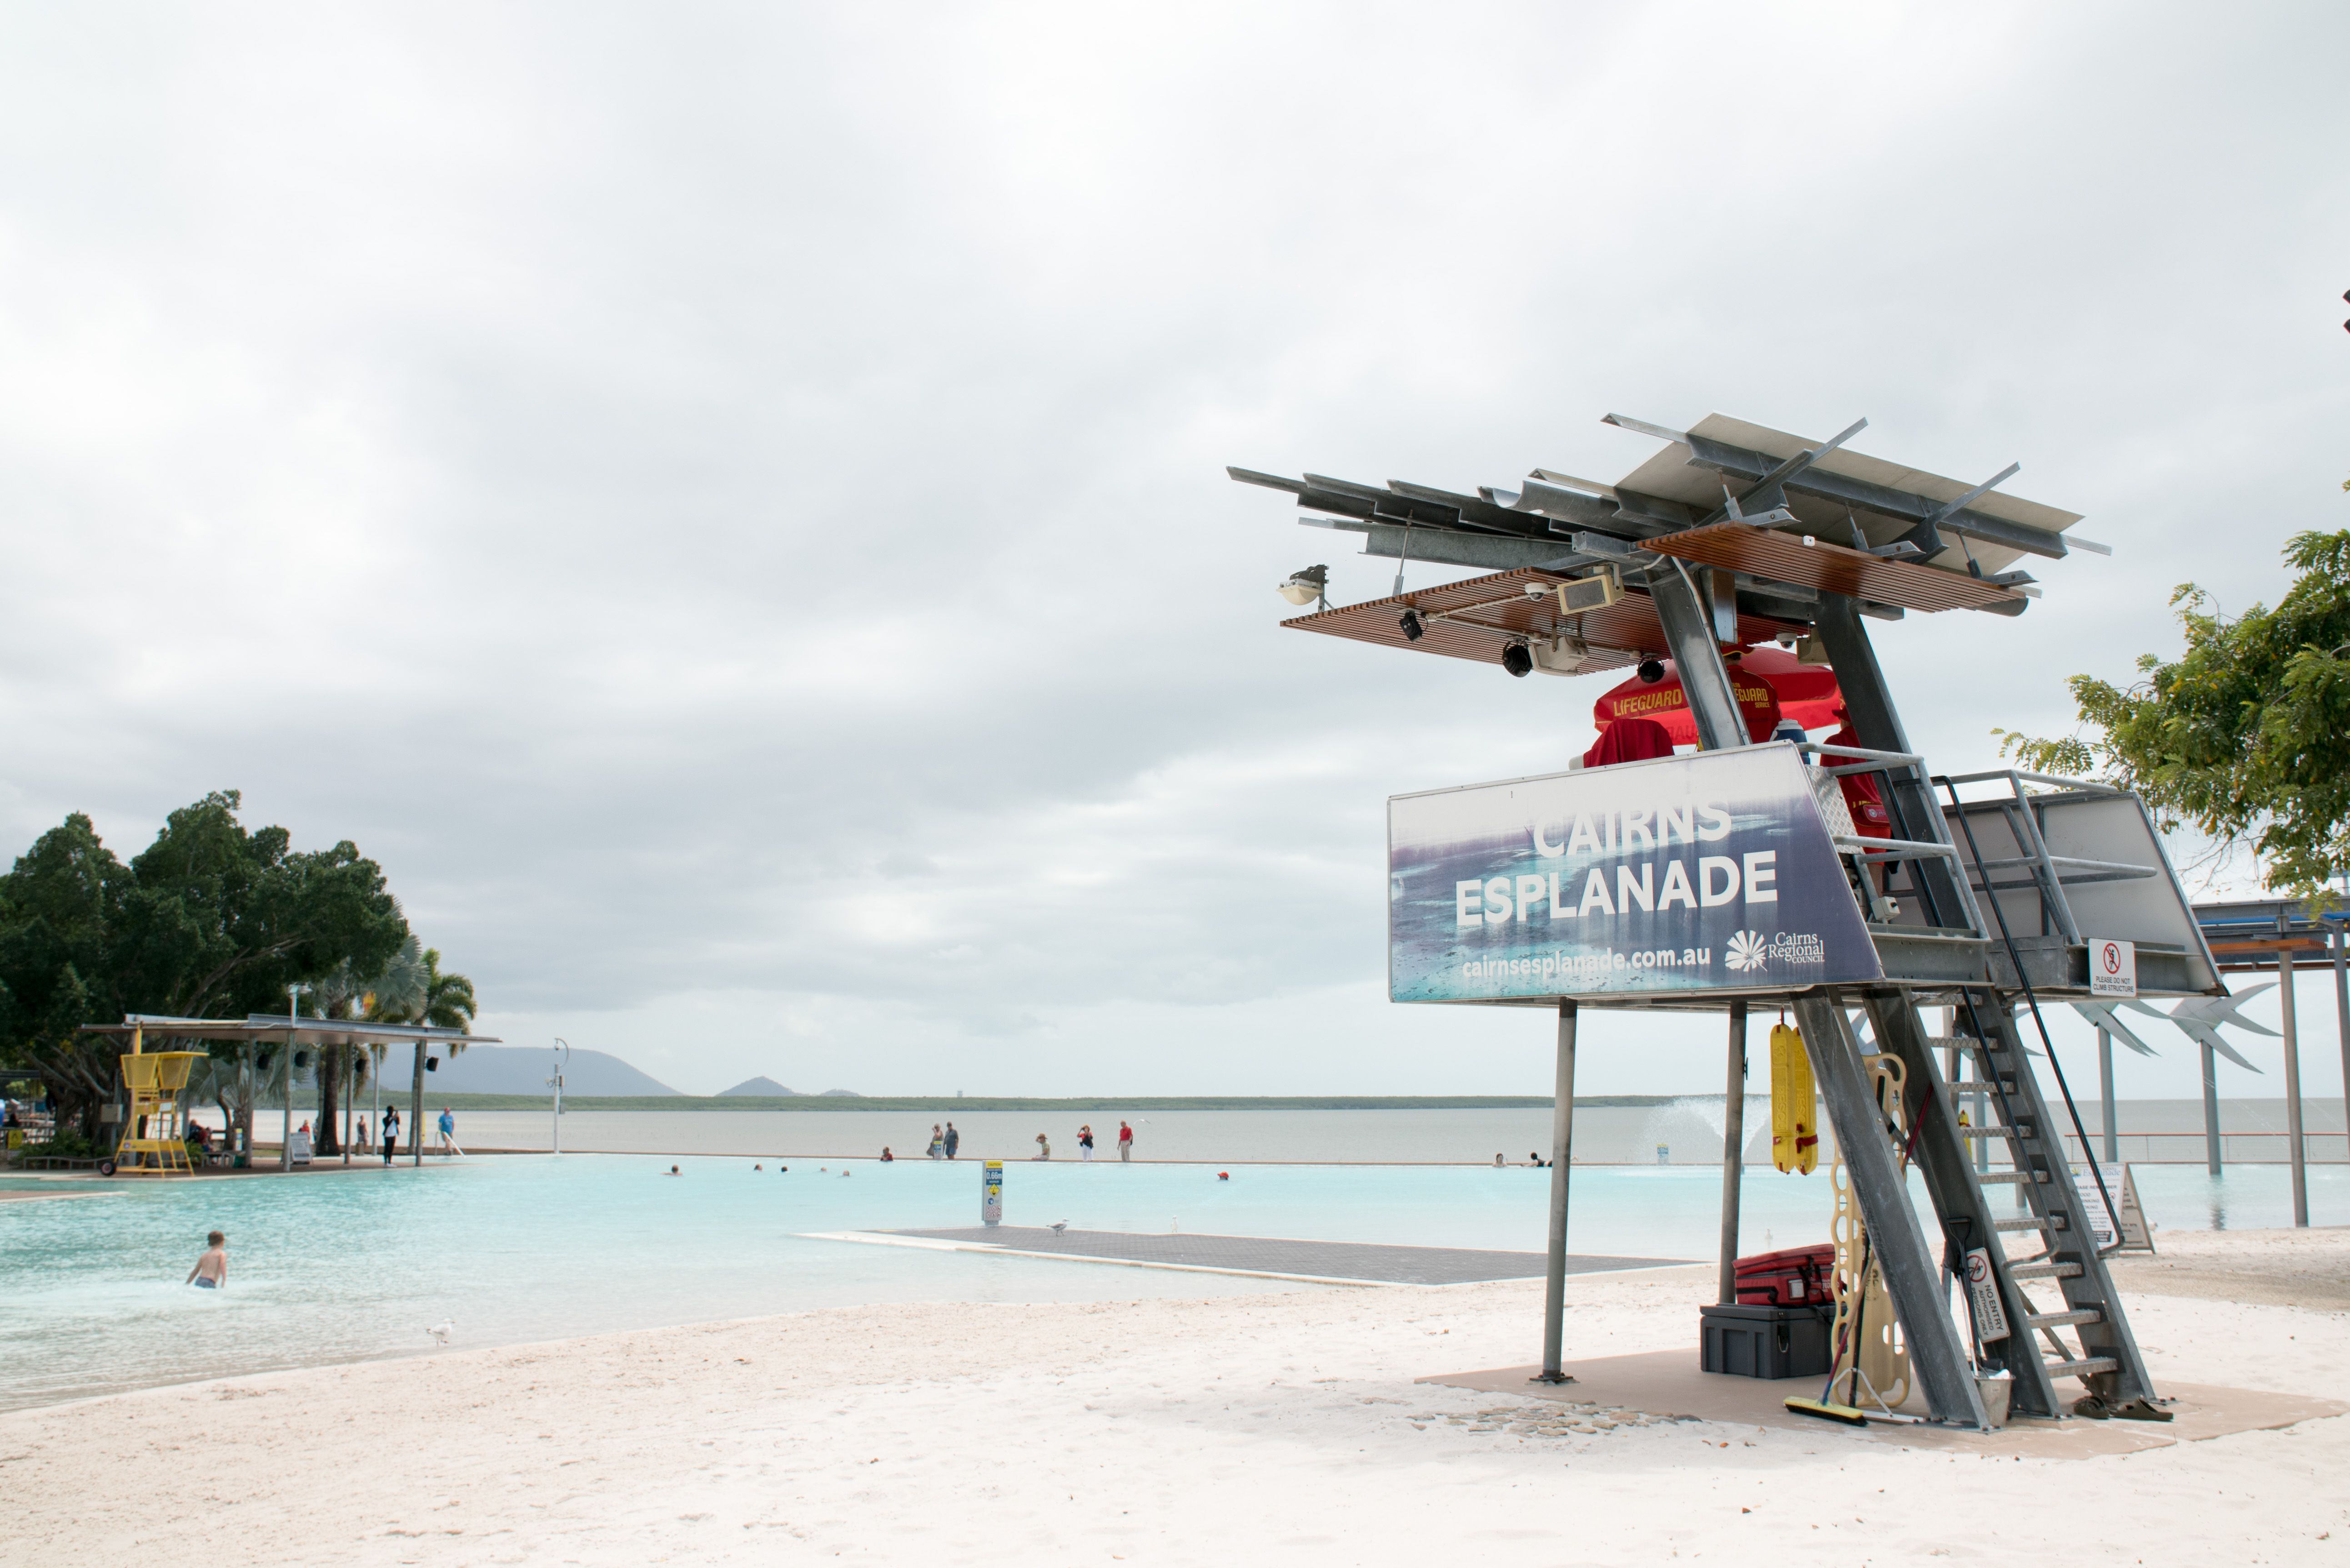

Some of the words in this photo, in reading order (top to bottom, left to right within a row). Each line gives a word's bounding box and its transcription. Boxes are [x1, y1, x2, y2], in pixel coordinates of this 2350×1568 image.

[1614, 689, 1682, 717] LIFEGUARD
[1734, 688, 1768, 702] EGUARD
[1533, 791, 1732, 858] CAIRNS
[1456, 850, 1778, 926] ESPLANADE
[1768, 940, 1824, 961] Regional
[1775, 932, 1818, 946] Cairns
[1462, 947, 1711, 980] cairnsesplanade.com.au
[1792, 955, 1825, 964] COUNCIL
[1777, 1085, 1787, 1129] RESCU
[1972, 1287, 1983, 1318] PERSONS
[1980, 1319, 1988, 1336] ONLY
[1978, 1290, 1993, 1331] AUTHORISED
[1984, 1284, 1993, 1298] NO
[1989, 1300, 2004, 1330] ENTRY
